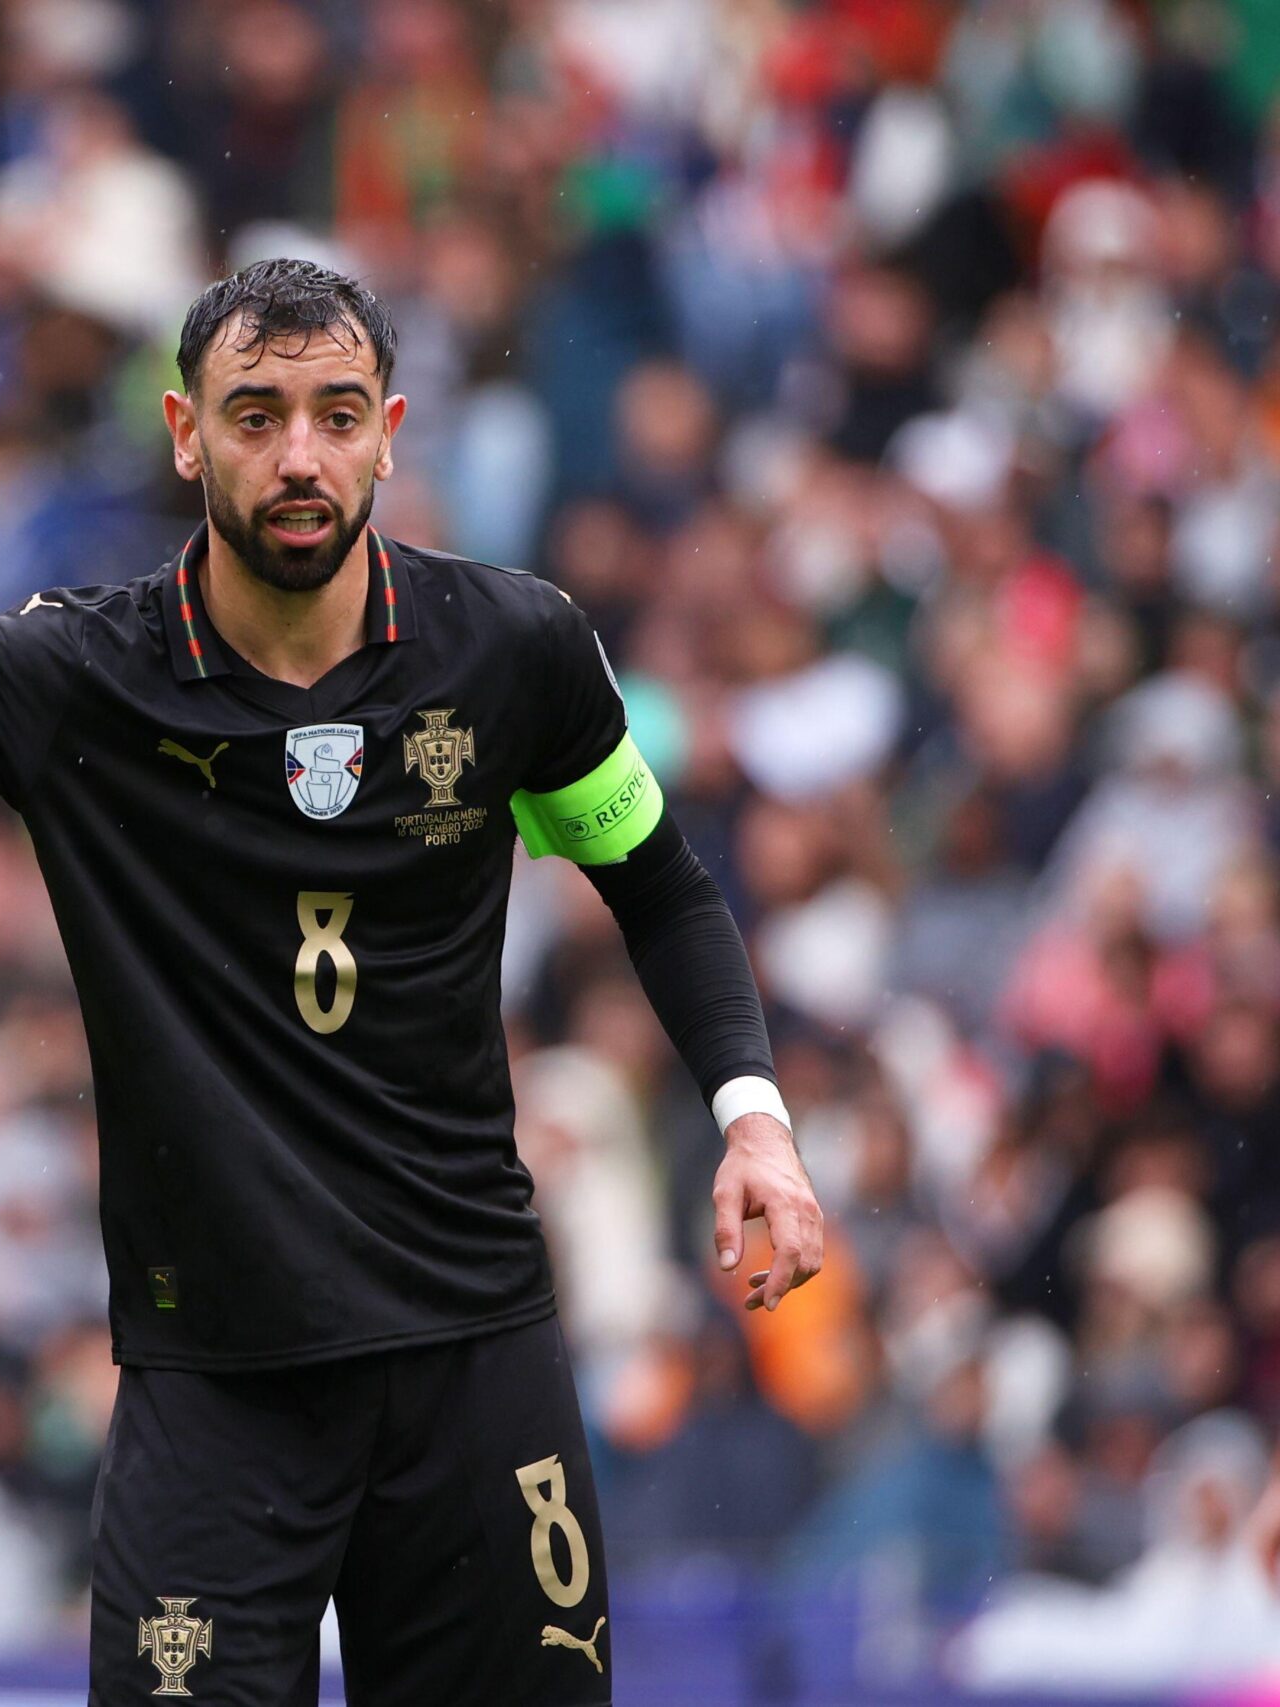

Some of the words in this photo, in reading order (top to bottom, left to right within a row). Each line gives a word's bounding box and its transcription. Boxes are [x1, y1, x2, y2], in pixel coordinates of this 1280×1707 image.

[291, 732, 307, 740] UEFA
[308, 728, 336, 736] NATIONS
[337, 728, 360, 736] LEAGUE
[304, 805, 329, 816] WINNER
[409, 822, 461, 837] NOVEMBRO
[463, 818, 484, 832] 2025
[425, 833, 461, 846] PORTO
[294, 891, 357, 1034] 8
[515, 1453, 590, 1608] 8
